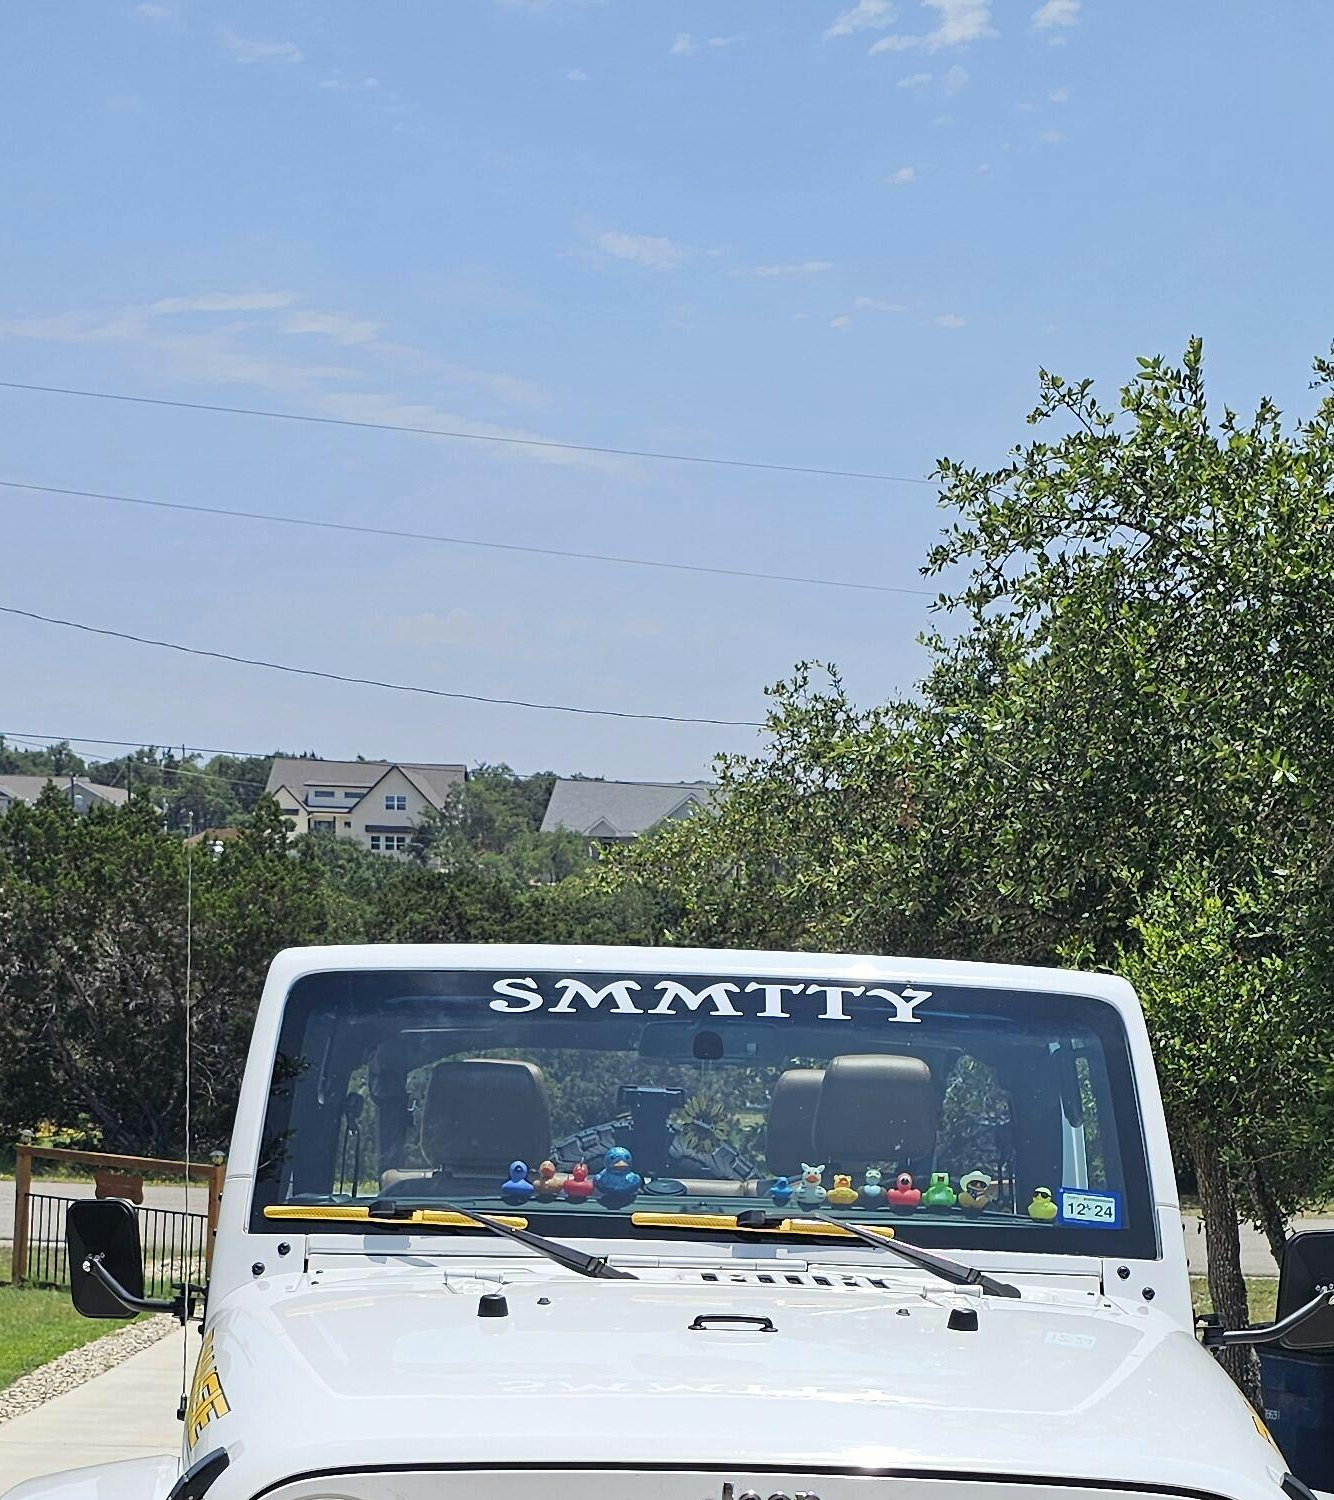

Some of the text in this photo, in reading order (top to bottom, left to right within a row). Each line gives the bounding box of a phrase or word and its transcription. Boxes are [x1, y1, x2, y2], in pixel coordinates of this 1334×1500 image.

[488, 976, 933, 1023] SMMTTY
[1067, 1202, 1113, 1218] 12 24
